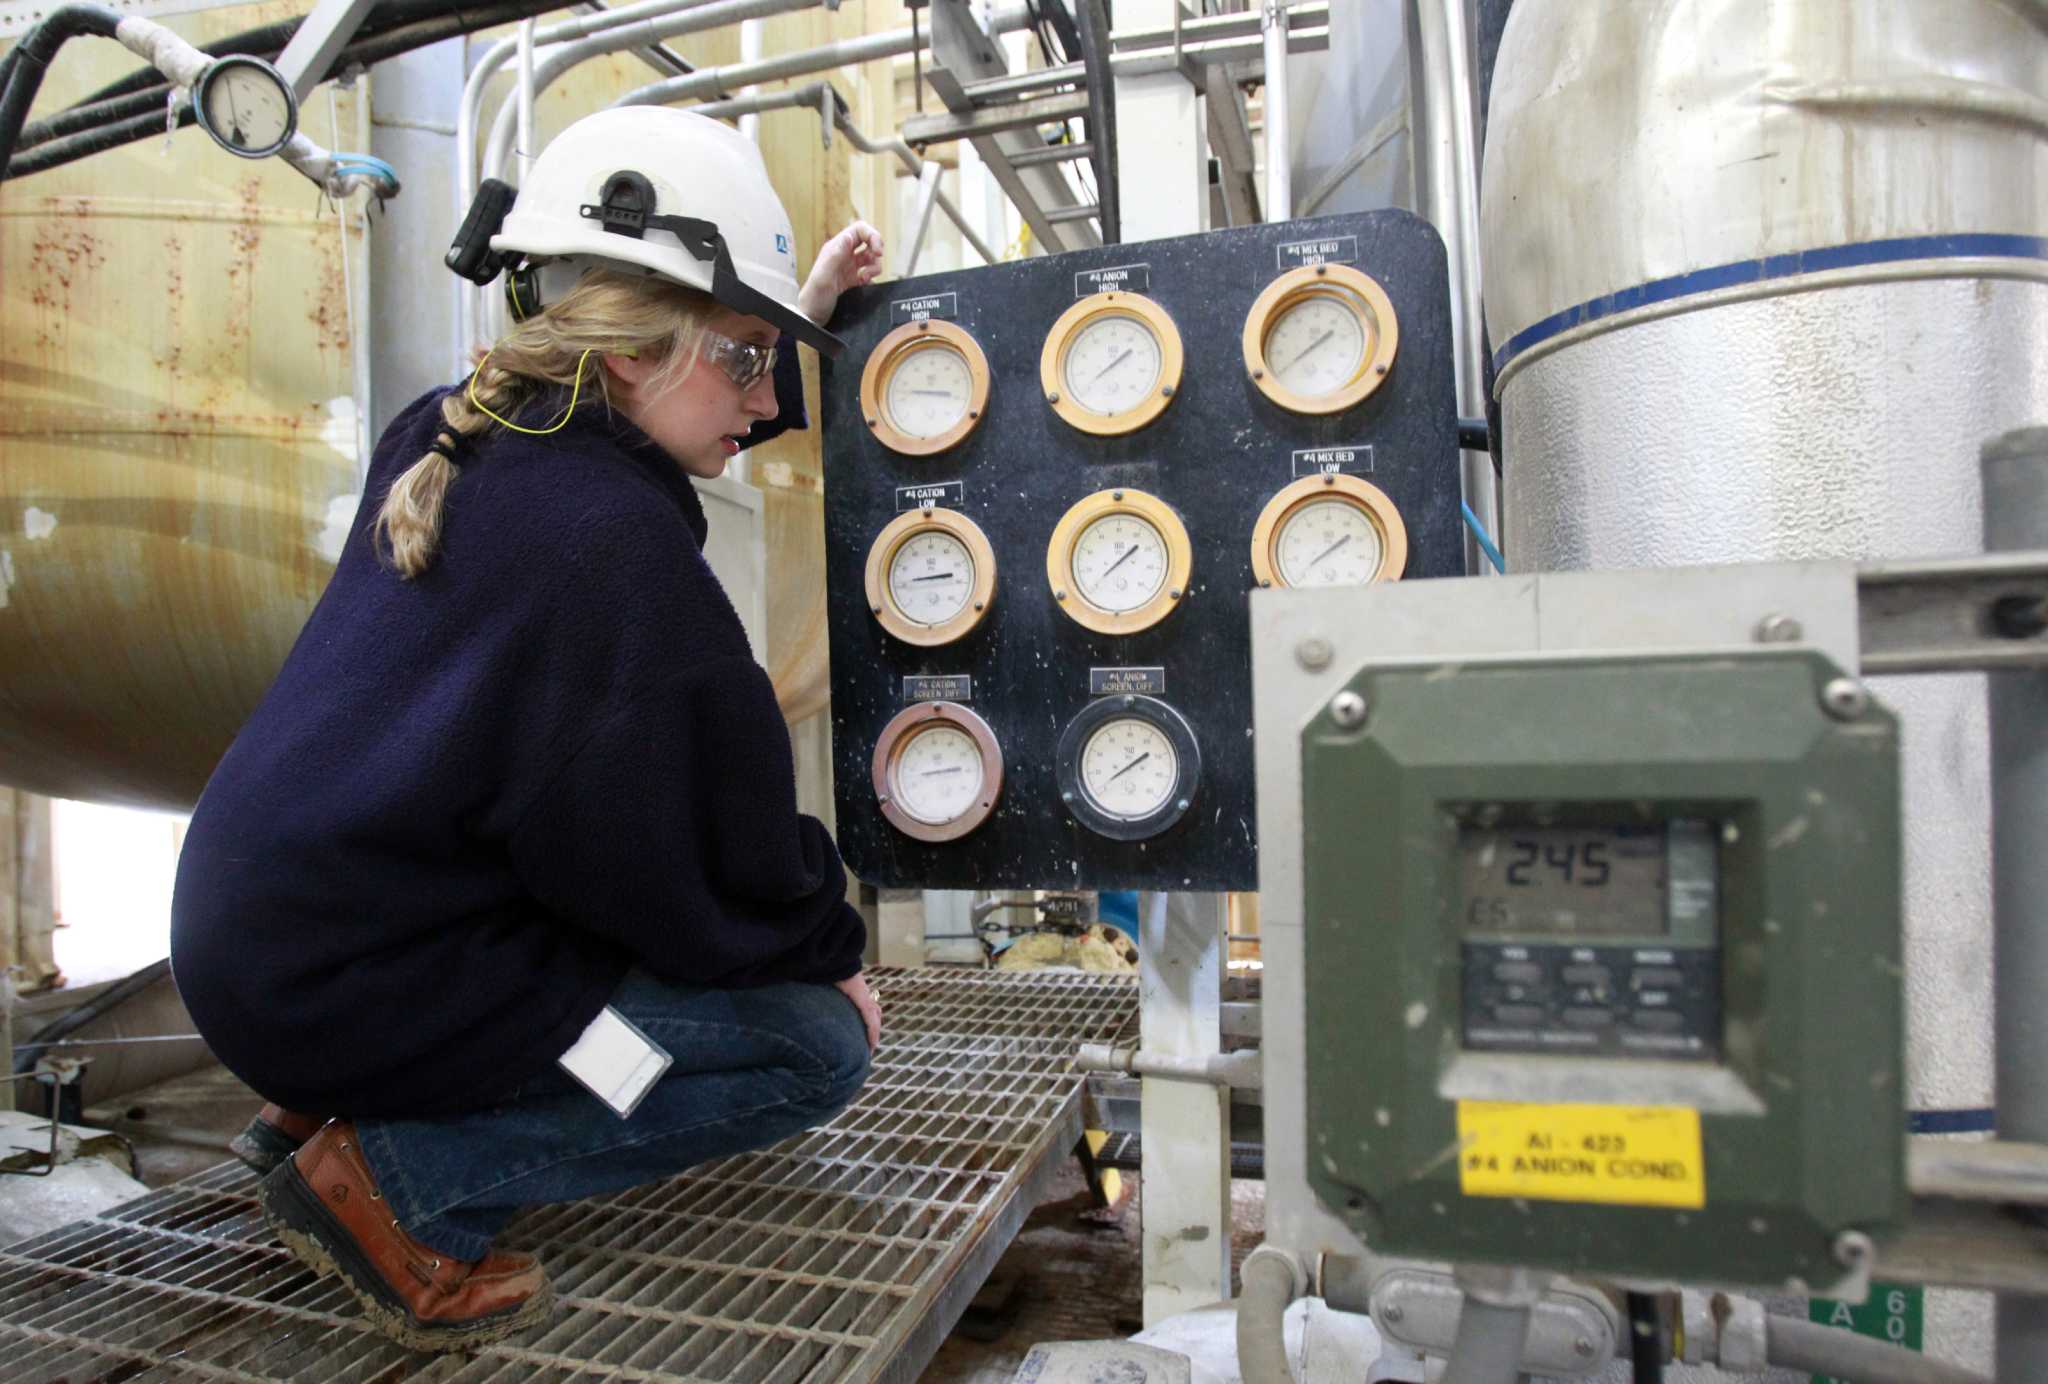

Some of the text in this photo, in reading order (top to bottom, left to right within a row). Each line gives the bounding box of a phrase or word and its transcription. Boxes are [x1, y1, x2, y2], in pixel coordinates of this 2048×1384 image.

[1302, 243, 1318, 254] MIX
[1319, 242, 1338, 253] BED
[1102, 270, 1129, 282] ANION
[1098, 282, 1119, 293] HIGH
[912, 299, 940, 311] CATION
[911, 310, 930, 321] HIGH
[1317, 451, 1334, 462] MIX
[1335, 450, 1355, 462] BED
[1320, 462, 1340, 473] LOW
[917, 487, 945, 498] CATION
[919, 498, 936, 508] LOW
[1466, 1155, 1688, 1181] #4 ANION COND
